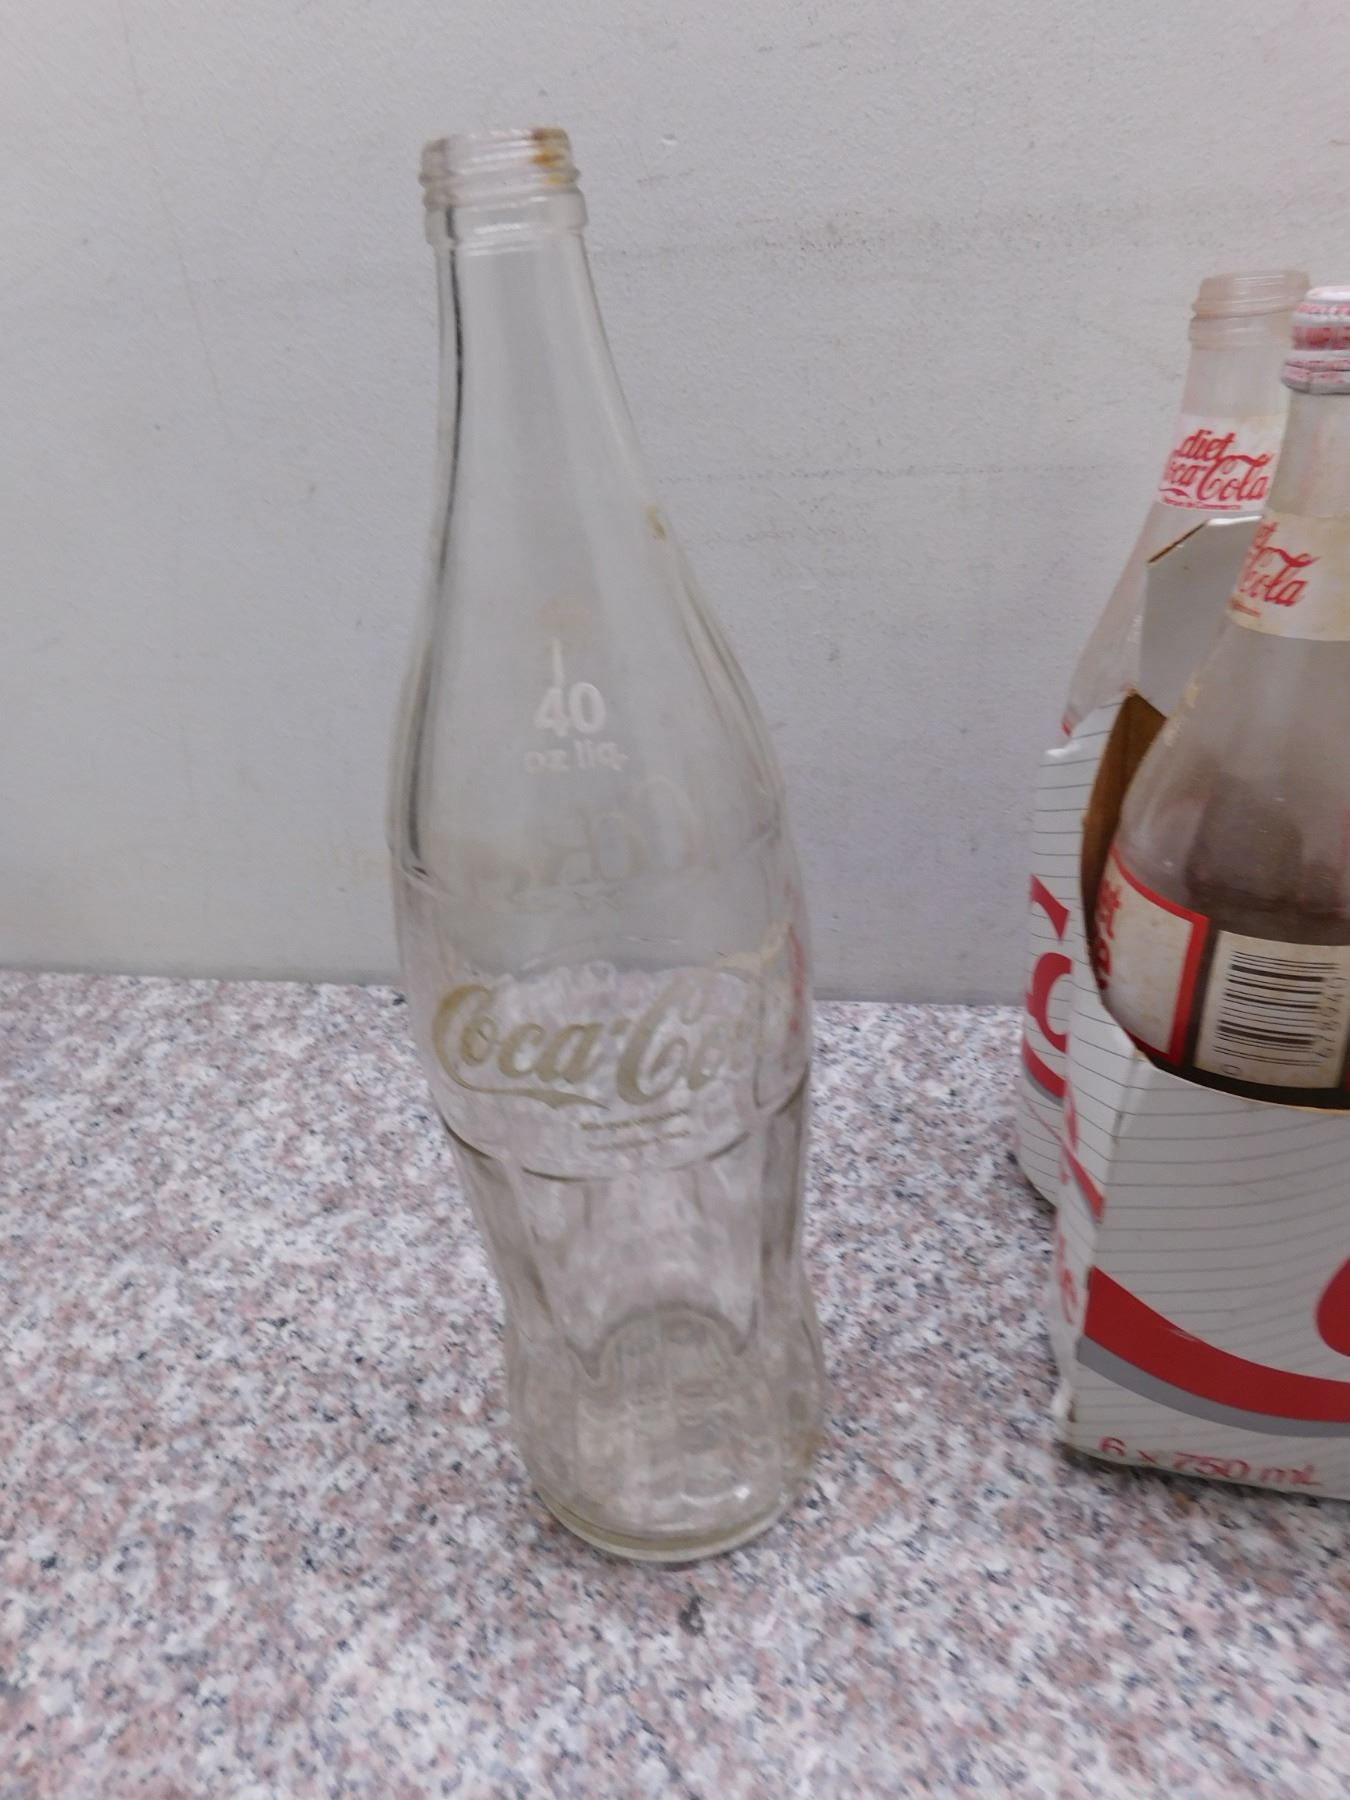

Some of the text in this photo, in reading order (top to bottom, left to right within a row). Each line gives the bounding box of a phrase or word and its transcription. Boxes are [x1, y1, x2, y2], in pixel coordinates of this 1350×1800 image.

[1173, 428, 1237, 462] diet
[533, 680, 608, 737] 40
[1171, 1451, 1251, 1480] 750
